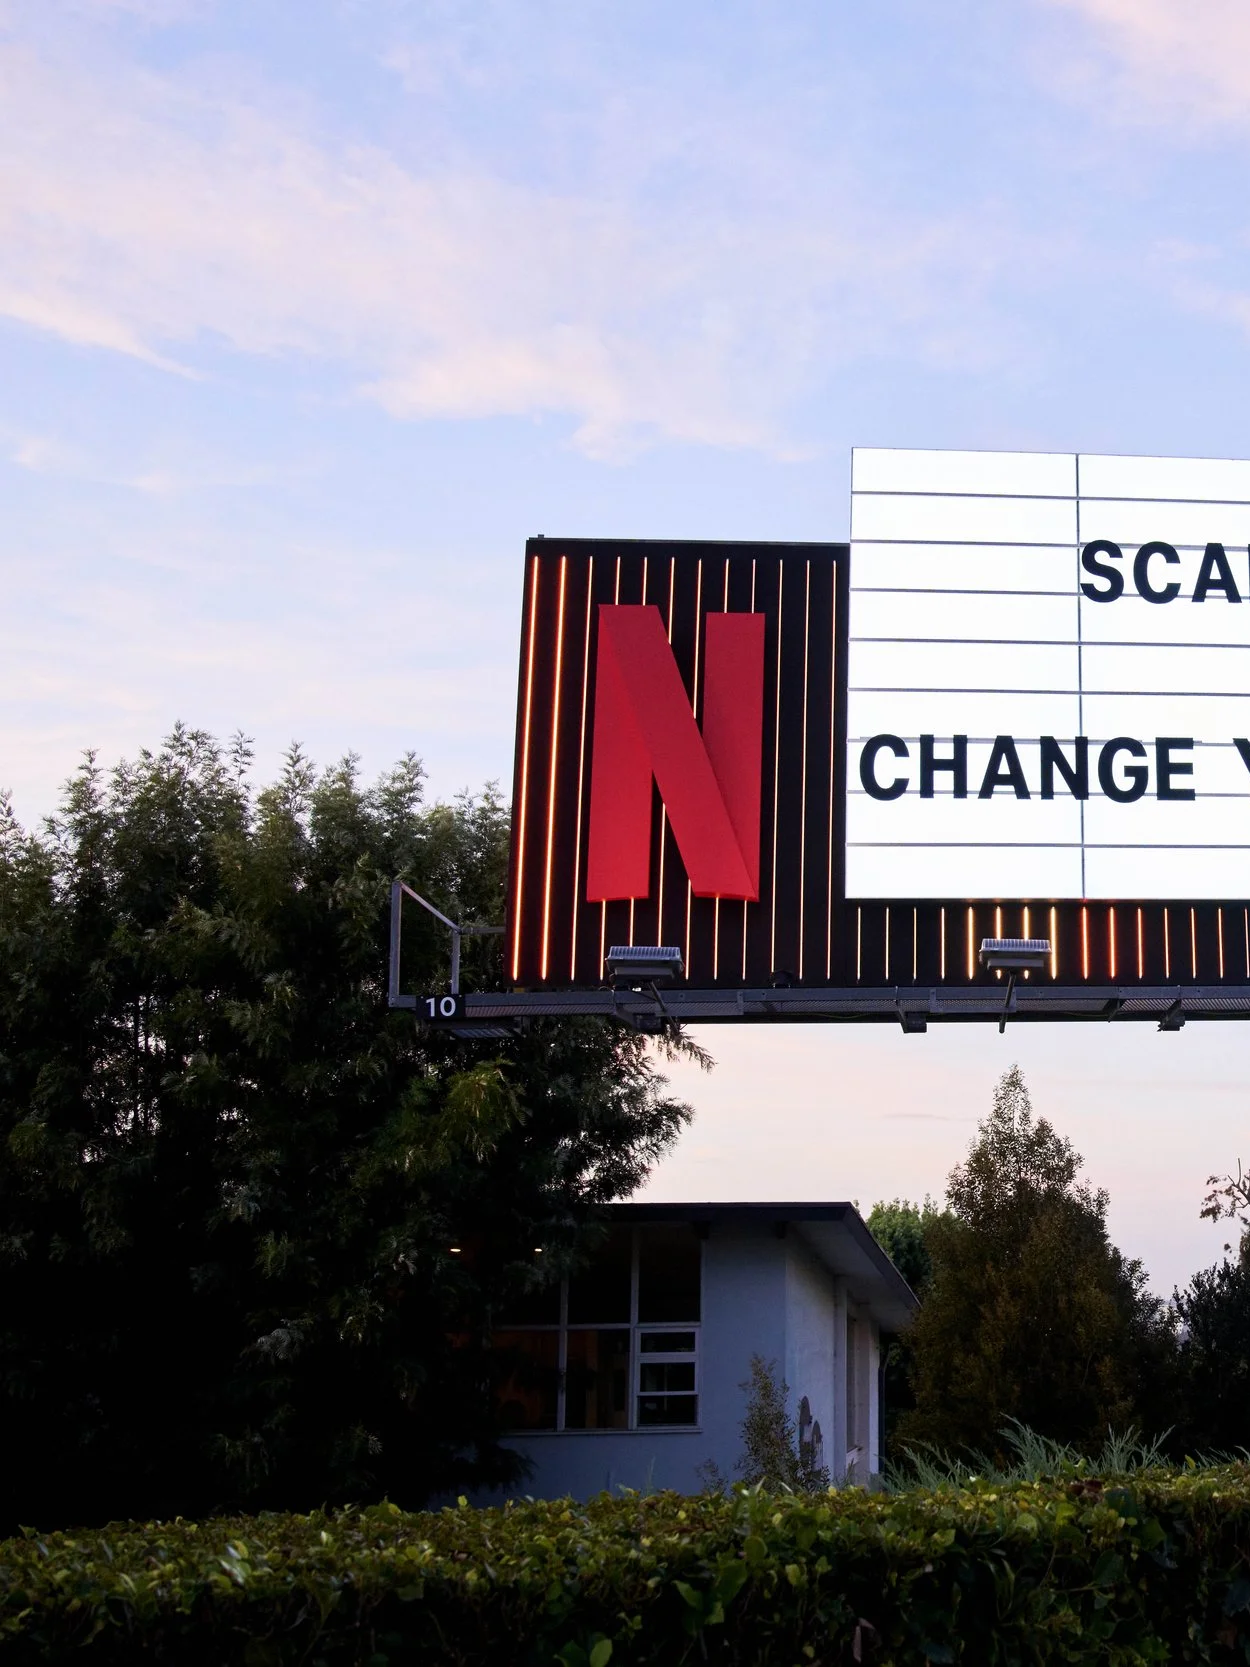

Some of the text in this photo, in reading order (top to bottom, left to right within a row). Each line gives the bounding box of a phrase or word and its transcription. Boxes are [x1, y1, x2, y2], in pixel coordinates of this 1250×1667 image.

[587, 603, 765, 902] N
[859, 734, 1196, 803] CHANGE
[425, 996, 456, 1017] 10
